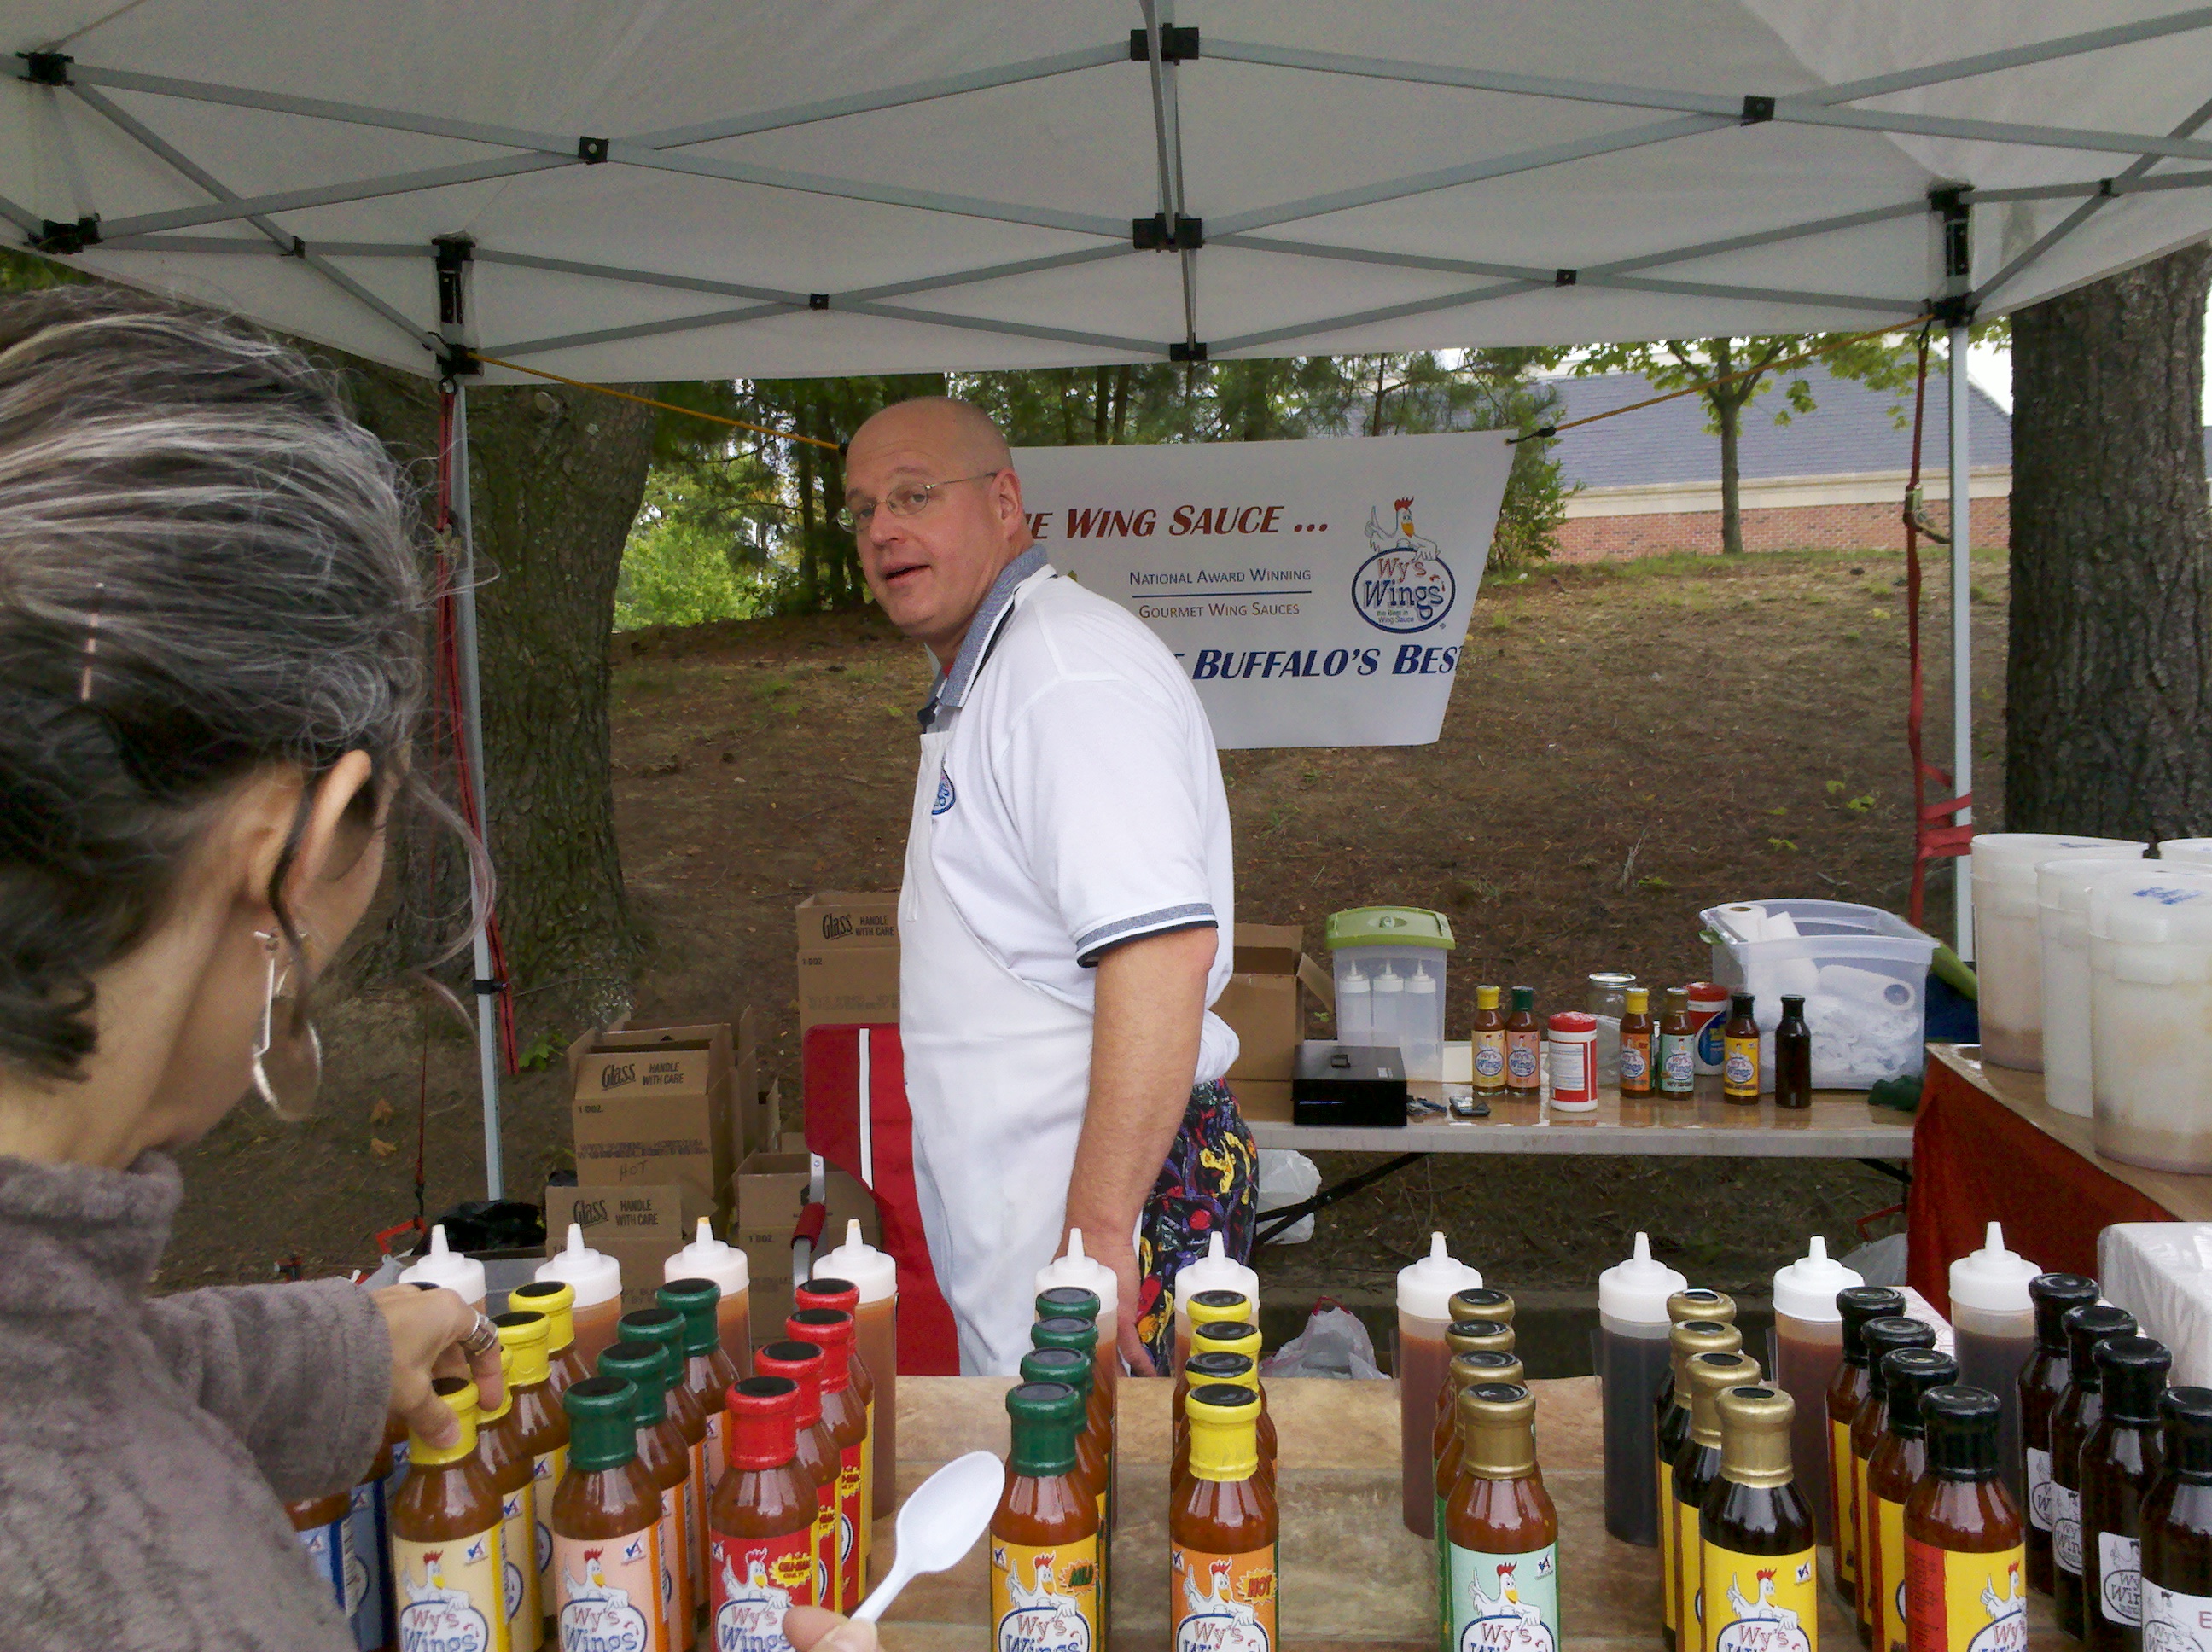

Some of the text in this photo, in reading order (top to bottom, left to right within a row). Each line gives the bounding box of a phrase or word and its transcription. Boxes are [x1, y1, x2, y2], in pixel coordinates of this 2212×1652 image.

[1067, 507, 1156, 538] WING
[1168, 504, 1285, 537] SAUCE
[1129, 567, 1312, 585] NATIONAL AWARD WINNING
[1377, 557, 1427, 583] Wy's
[1139, 601, 1300, 619] GOURMET WING SAUCES
[1365, 579, 1444, 620] Wings
[1192, 647, 1381, 679] BUFFALO'S
[823, 913, 853, 939] Glass
[855, 927, 894, 936] WITH CARE
[860, 915, 888, 925] HANDLE
[602, 1063, 636, 1089] Glass
[643, 1073, 684, 1086] WITH CARE
[649, 1062, 680, 1073] HANDLE
[620, 1160, 648, 1181] HOT
[573, 1199, 608, 1226] Glass
[620, 1199, 652, 1212] HANDLE
[615, 1213, 658, 1226] WITH CARE
[1248, 1575, 1272, 1597] HOT
[412, 1608, 460, 1635] Wy's
[573, 1606, 620, 1632] Wy's
[731, 1606, 777, 1632] Wy's
[1017, 1614, 1067, 1642] Wy's
[1195, 1620, 1243, 1649] Wy's
[1481, 1623, 1532, 1651] Wy's
[1739, 1625, 1789, 1652] Wy's
